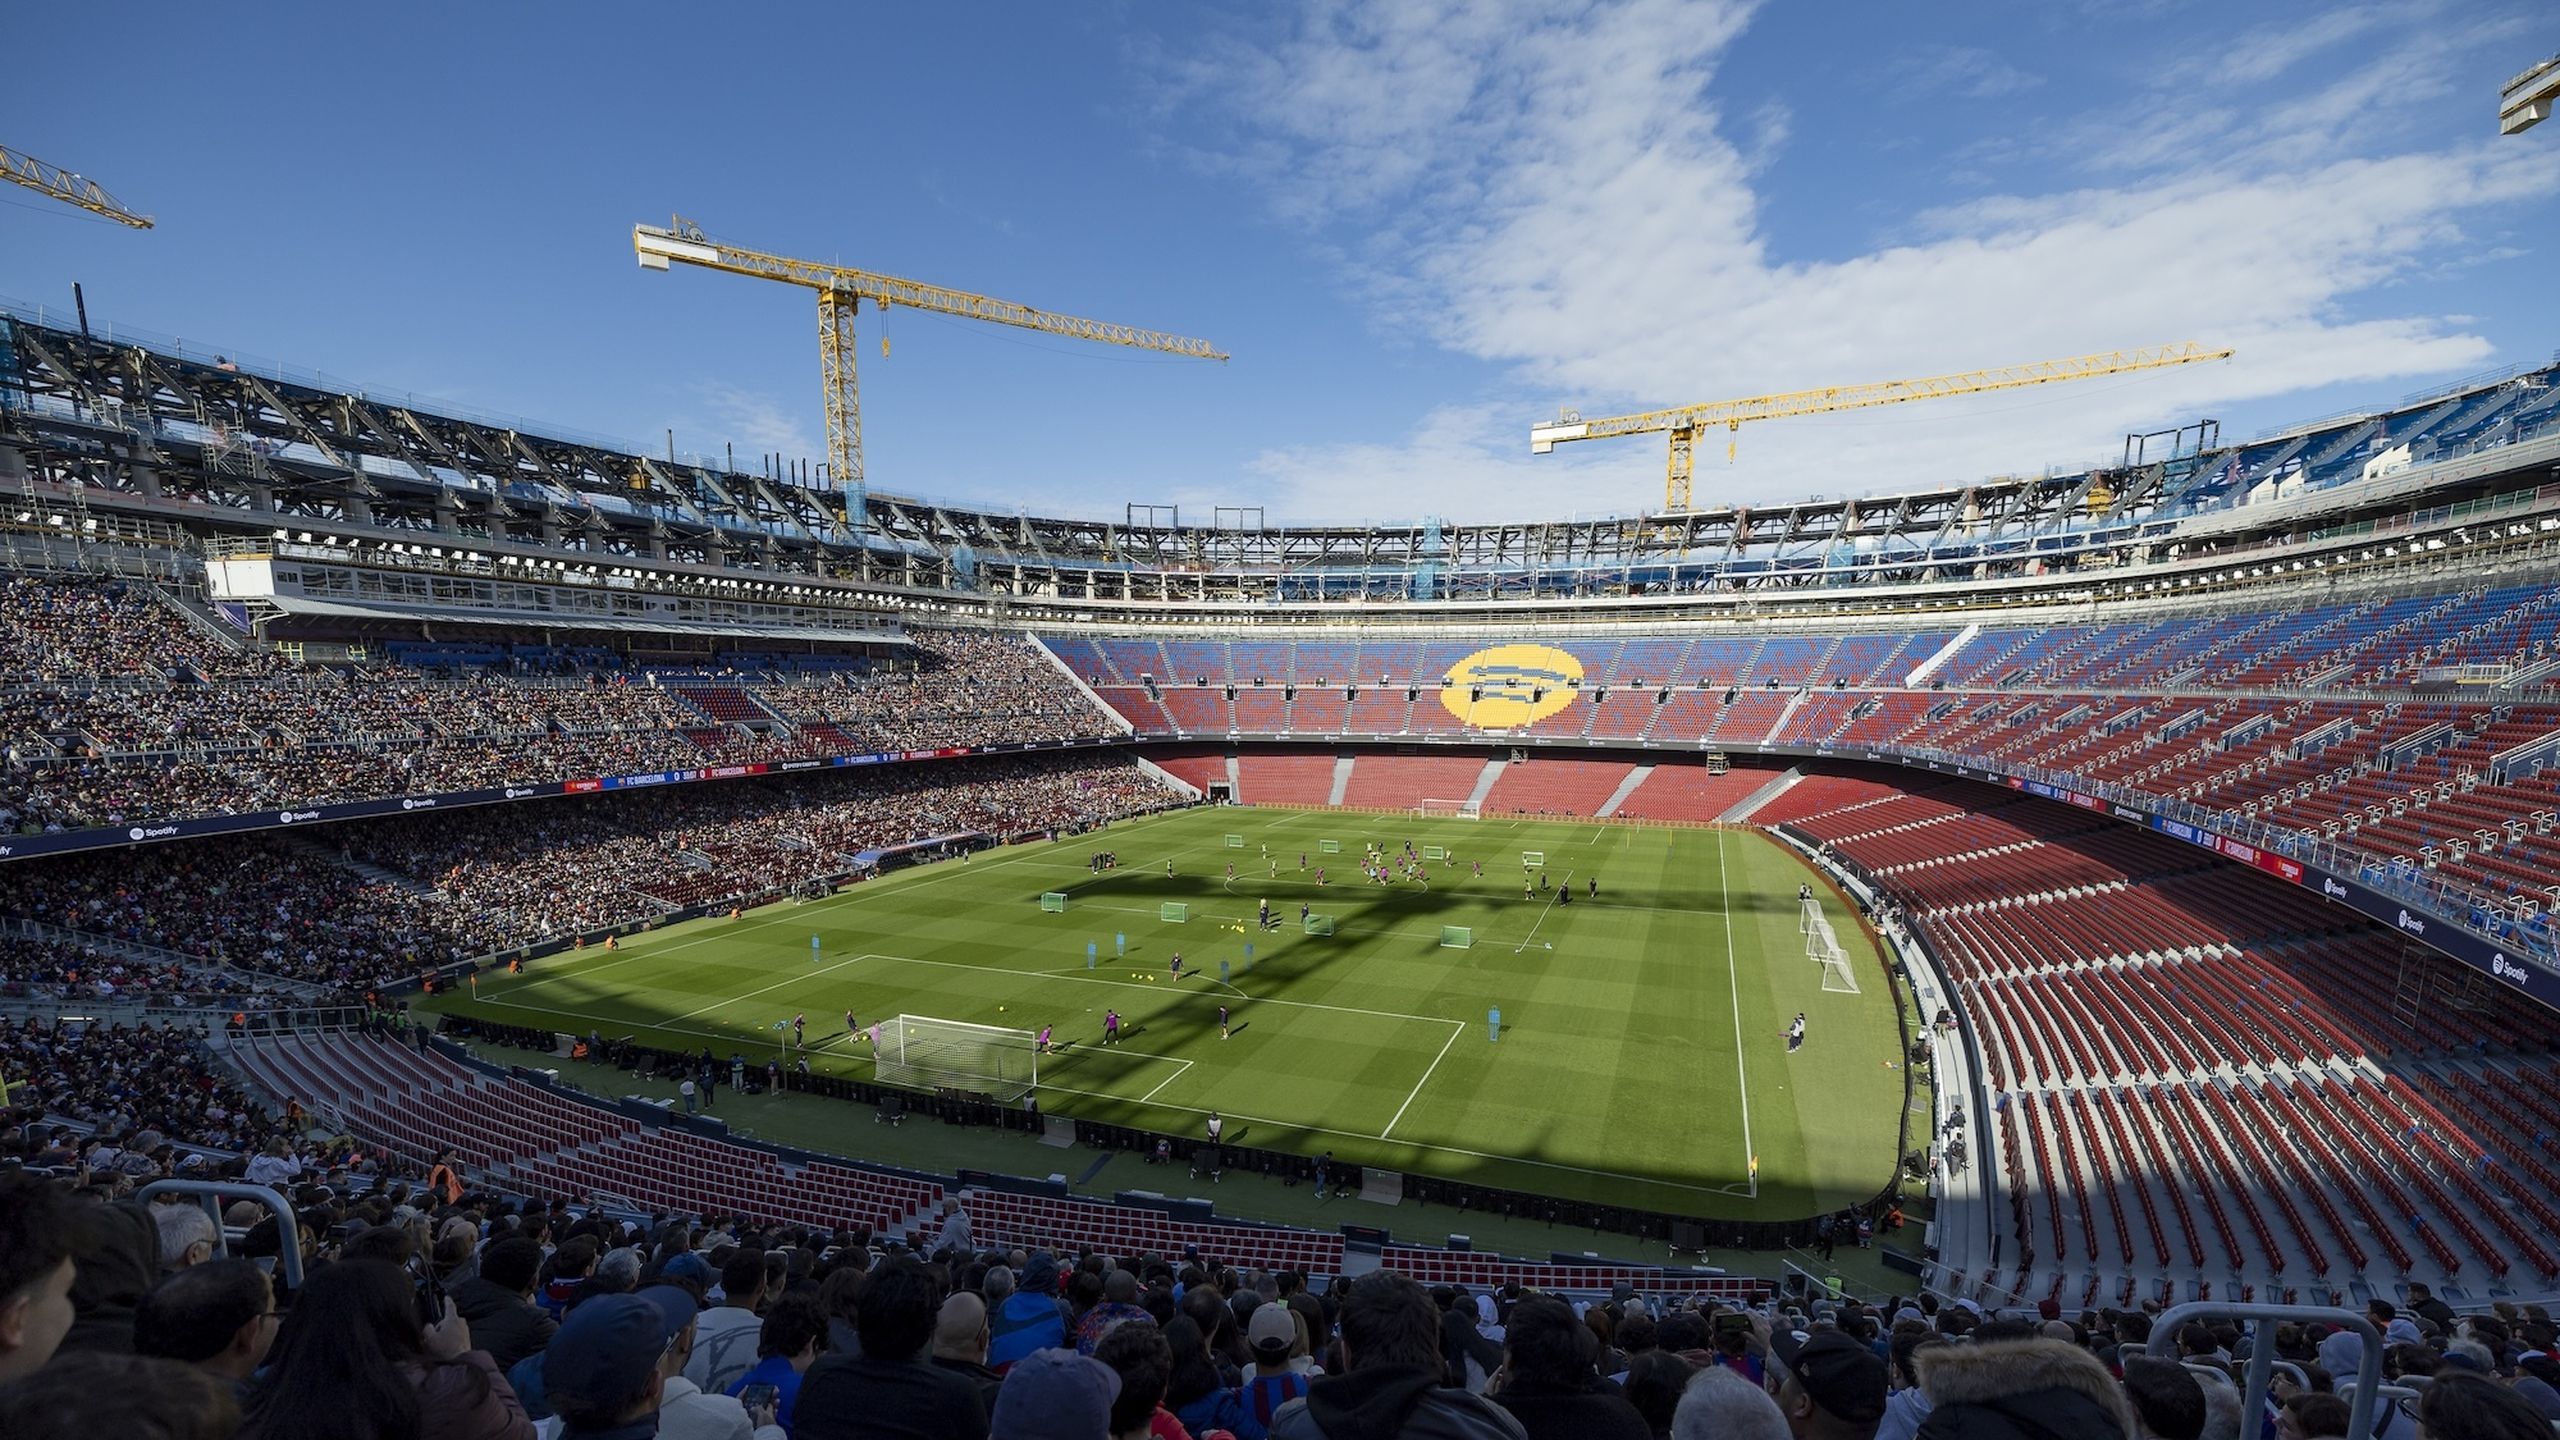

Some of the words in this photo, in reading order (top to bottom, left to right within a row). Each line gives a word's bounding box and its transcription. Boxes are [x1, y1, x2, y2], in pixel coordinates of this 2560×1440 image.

[626, 776, 634, 786] FC
[634, 774, 666, 785] BARCELONA
[674, 771, 680, 781] 0
[515, 788, 535, 797] Spotify
[413, 798, 436, 808] Spotify
[293, 811, 320, 821] Spotify
[146, 826, 178, 837] Spotify
[2331, 883, 2348, 899] Spotify
[2406, 916, 2425, 935] Spotify
[2504, 962, 2529, 985] Spotify
